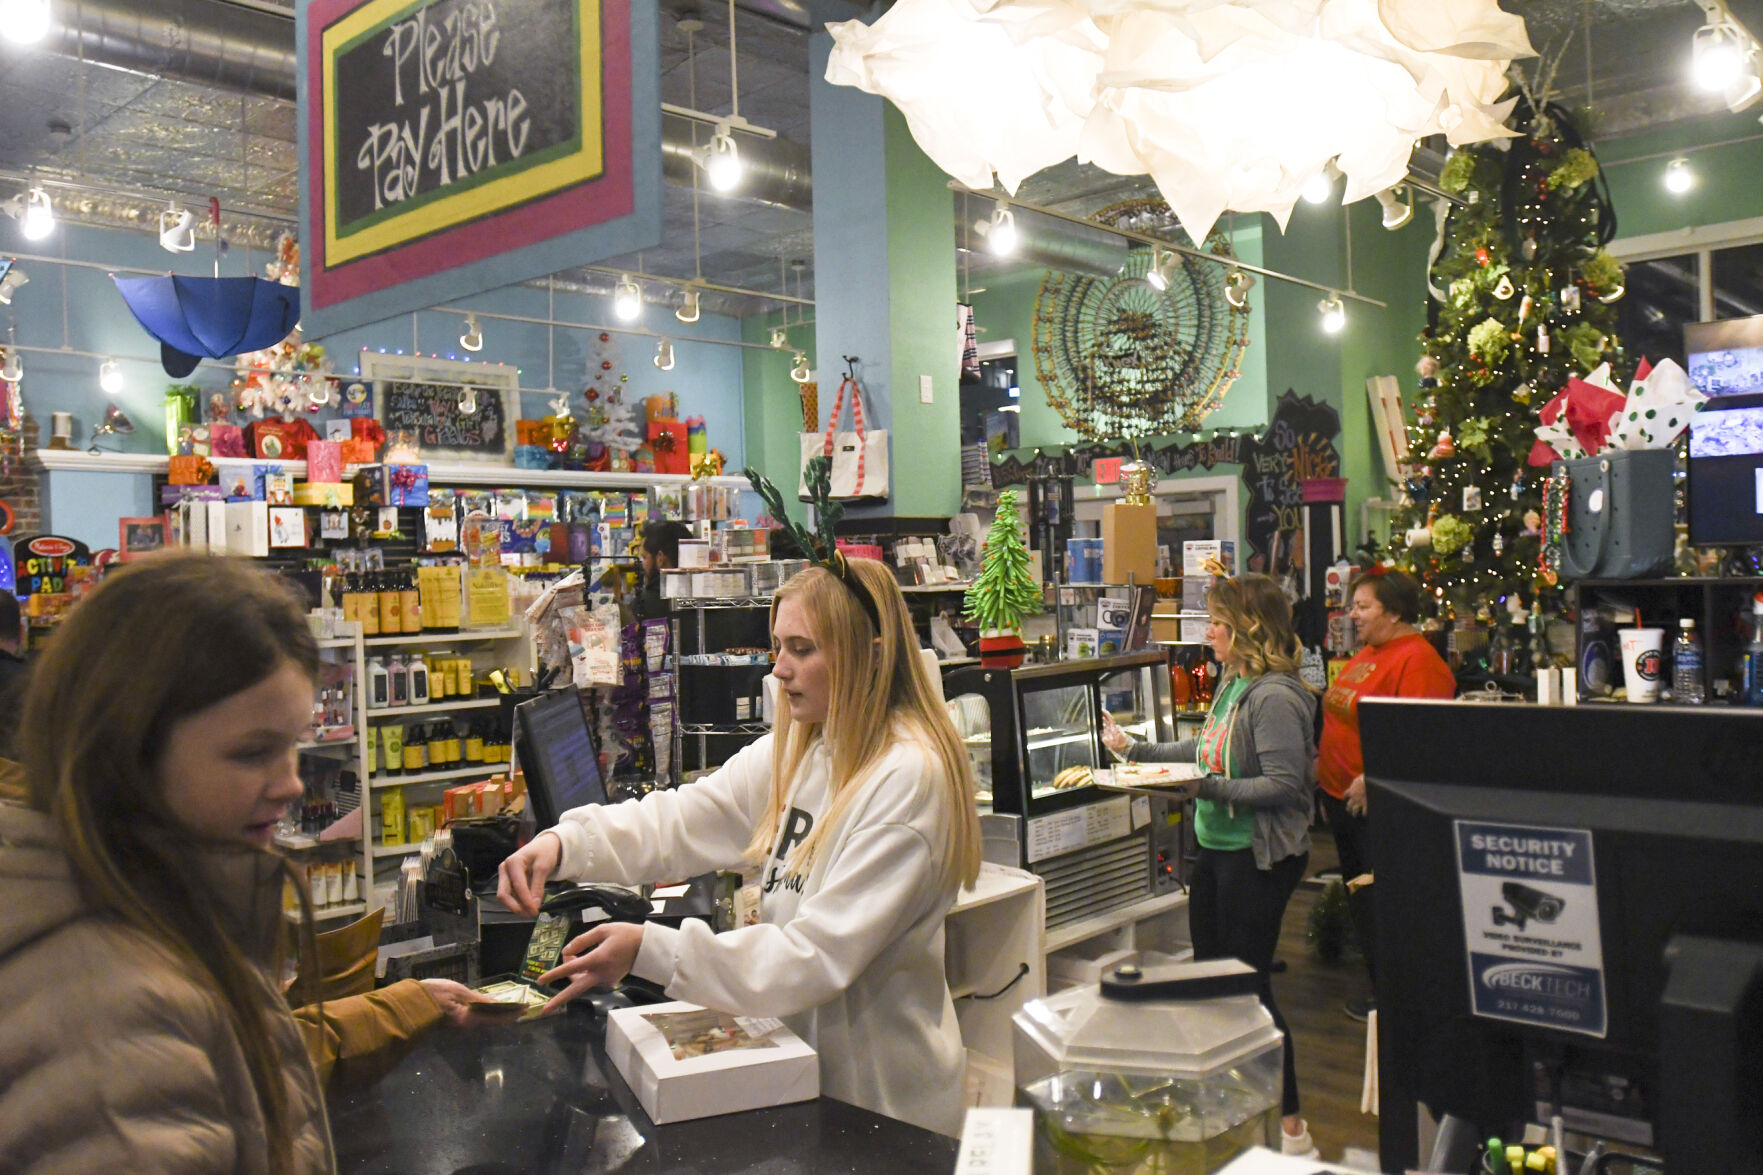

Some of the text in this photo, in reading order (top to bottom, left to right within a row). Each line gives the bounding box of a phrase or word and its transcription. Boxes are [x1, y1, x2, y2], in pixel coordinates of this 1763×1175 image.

[383, 1, 500, 106] Please
[357, 79, 531, 210] Pay Here
[31, 576, 64, 593] PAD
[1471, 834, 1576, 858] SECURITY
[1485, 854, 1564, 875] NOTICE
